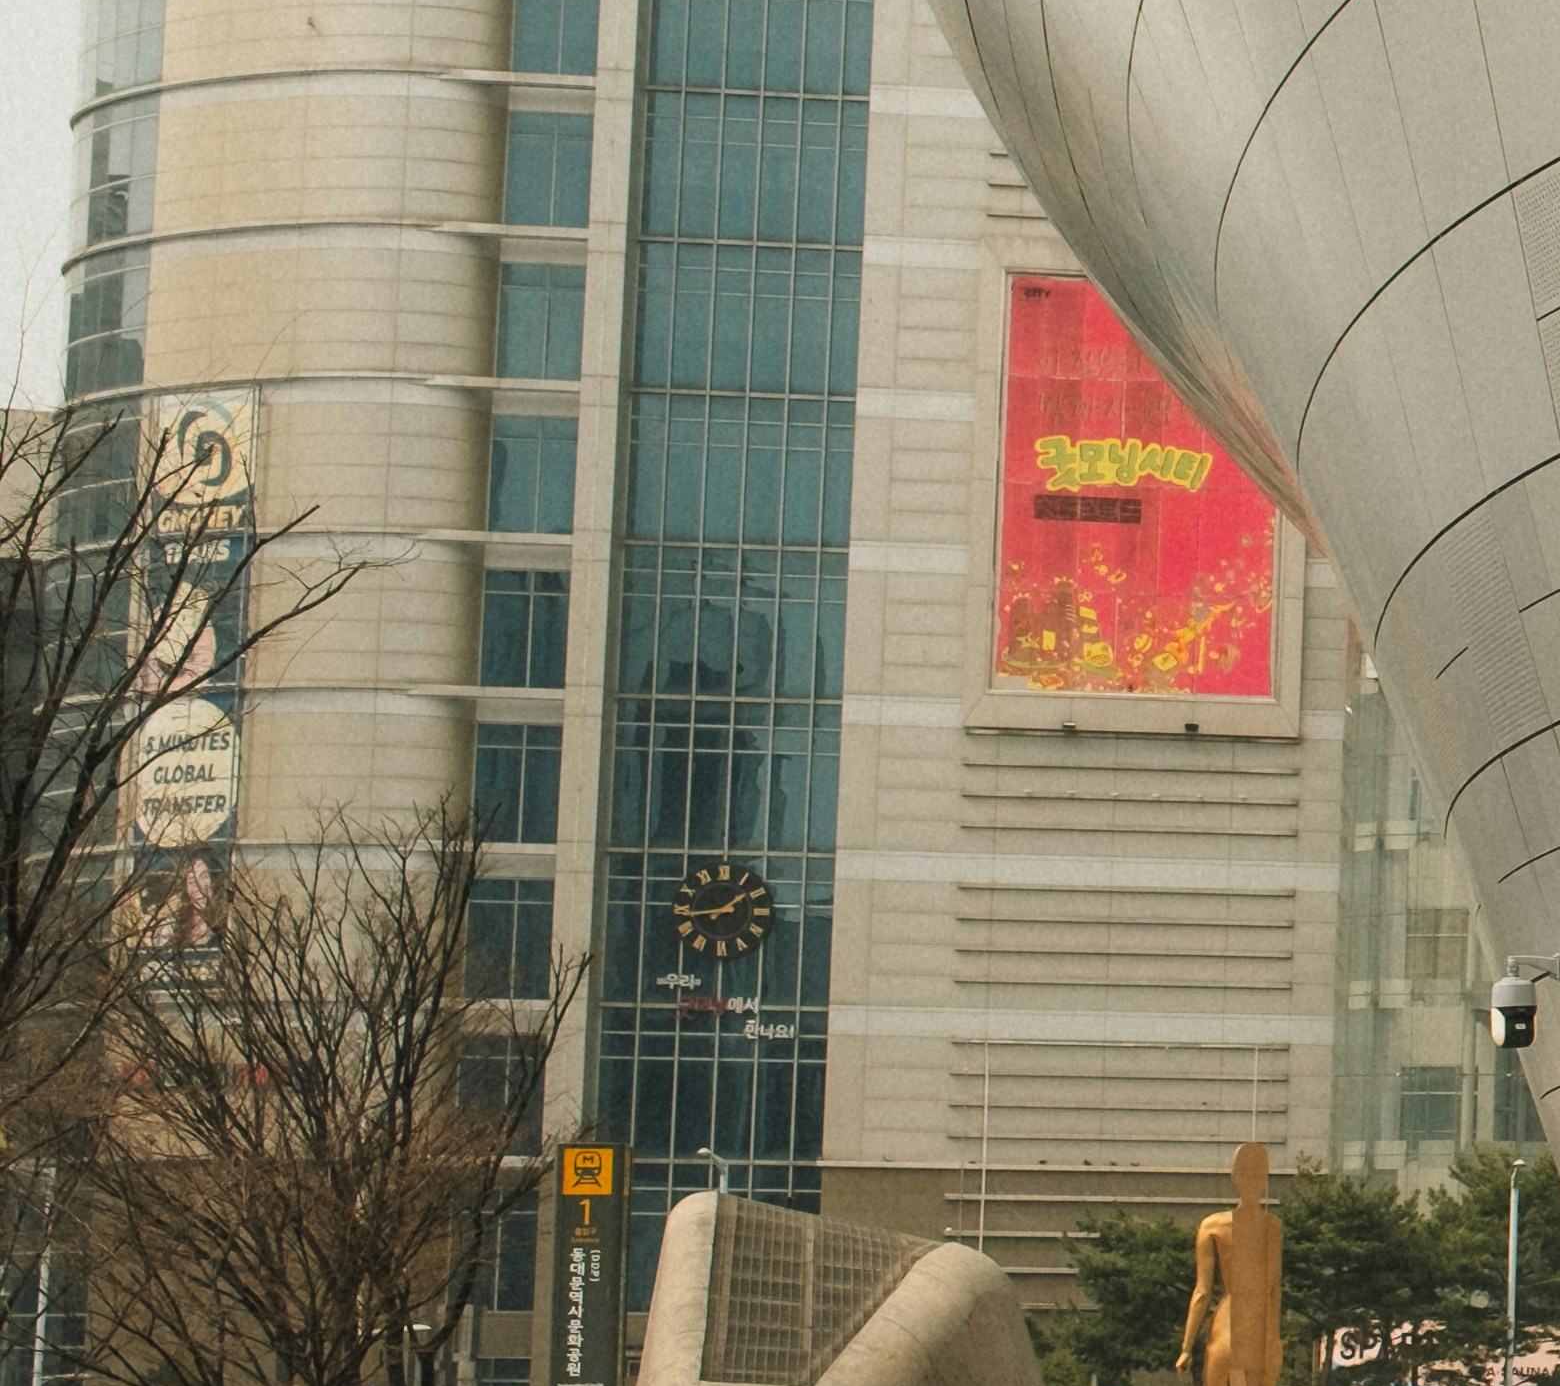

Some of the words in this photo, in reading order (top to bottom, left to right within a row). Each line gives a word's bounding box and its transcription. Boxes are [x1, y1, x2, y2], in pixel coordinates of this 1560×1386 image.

[1035, 435, 1213, 493] 굿모닝시티
[153, 764, 215, 784] GLOBAL
[666, 973, 695, 990] 우리
[579, 1198, 591, 1225] 1
[589, 1249, 602, 1282] (DDP)
[567, 1247, 586, 1377] 동대문역사문화공원
